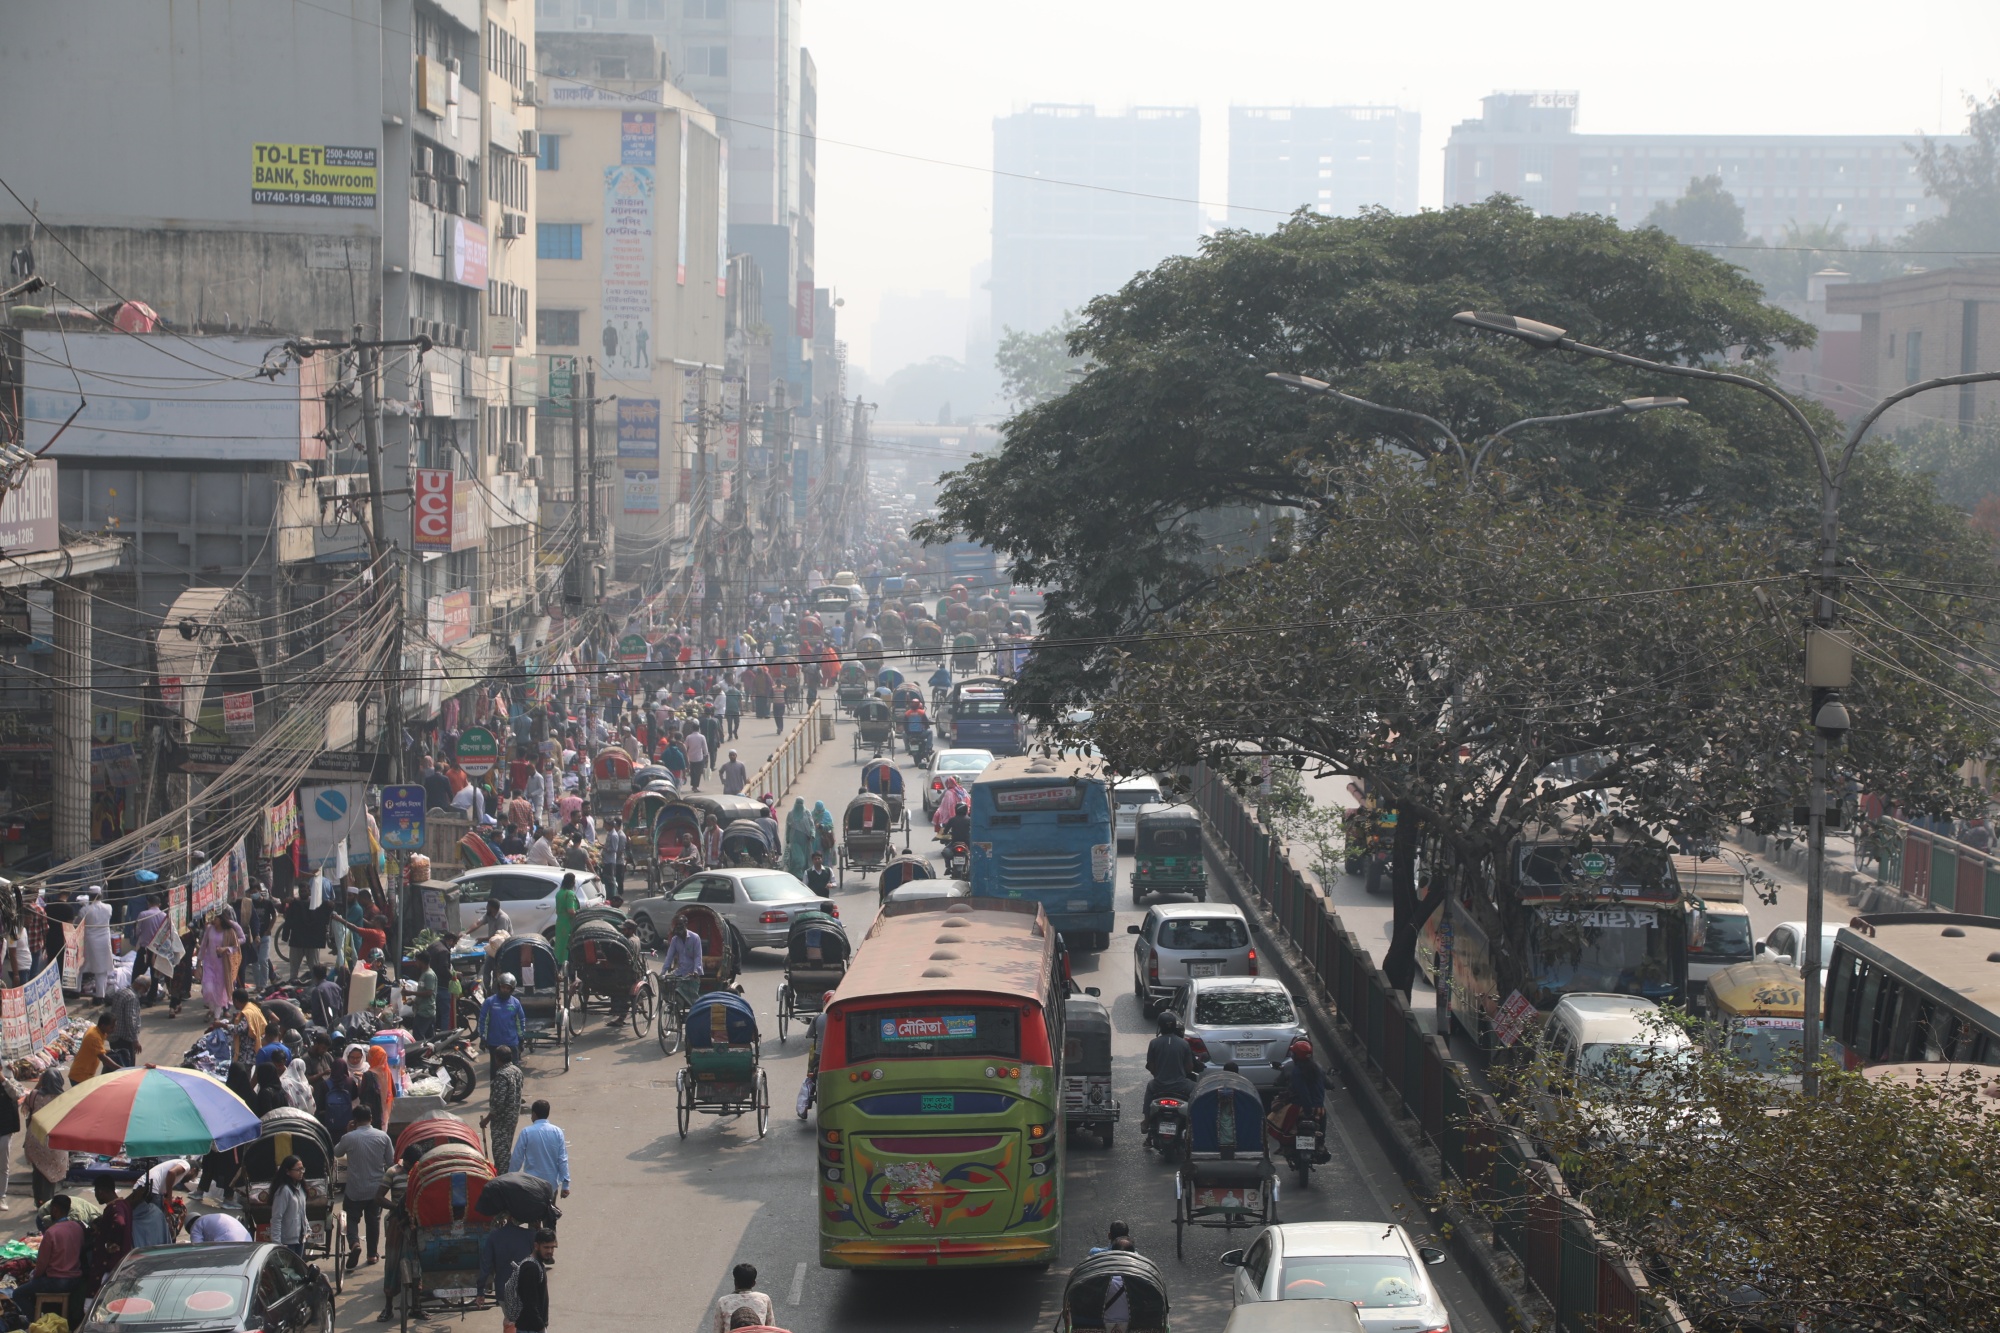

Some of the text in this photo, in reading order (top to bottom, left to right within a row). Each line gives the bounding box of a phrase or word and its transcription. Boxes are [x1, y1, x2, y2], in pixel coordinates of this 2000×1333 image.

[255, 145, 322, 165] TO-LET
[326, 148, 375, 160] 2500-4500 sft
[255, 167, 373, 188] BANK, Showroom
[255, 191, 374, 206] 01740-191-494, 01819-212-300
[19, 467, 52, 521] CENTER
[420, 471, 449, 536] UCC
[898, 1019, 943, 1035] মৌমিতা
